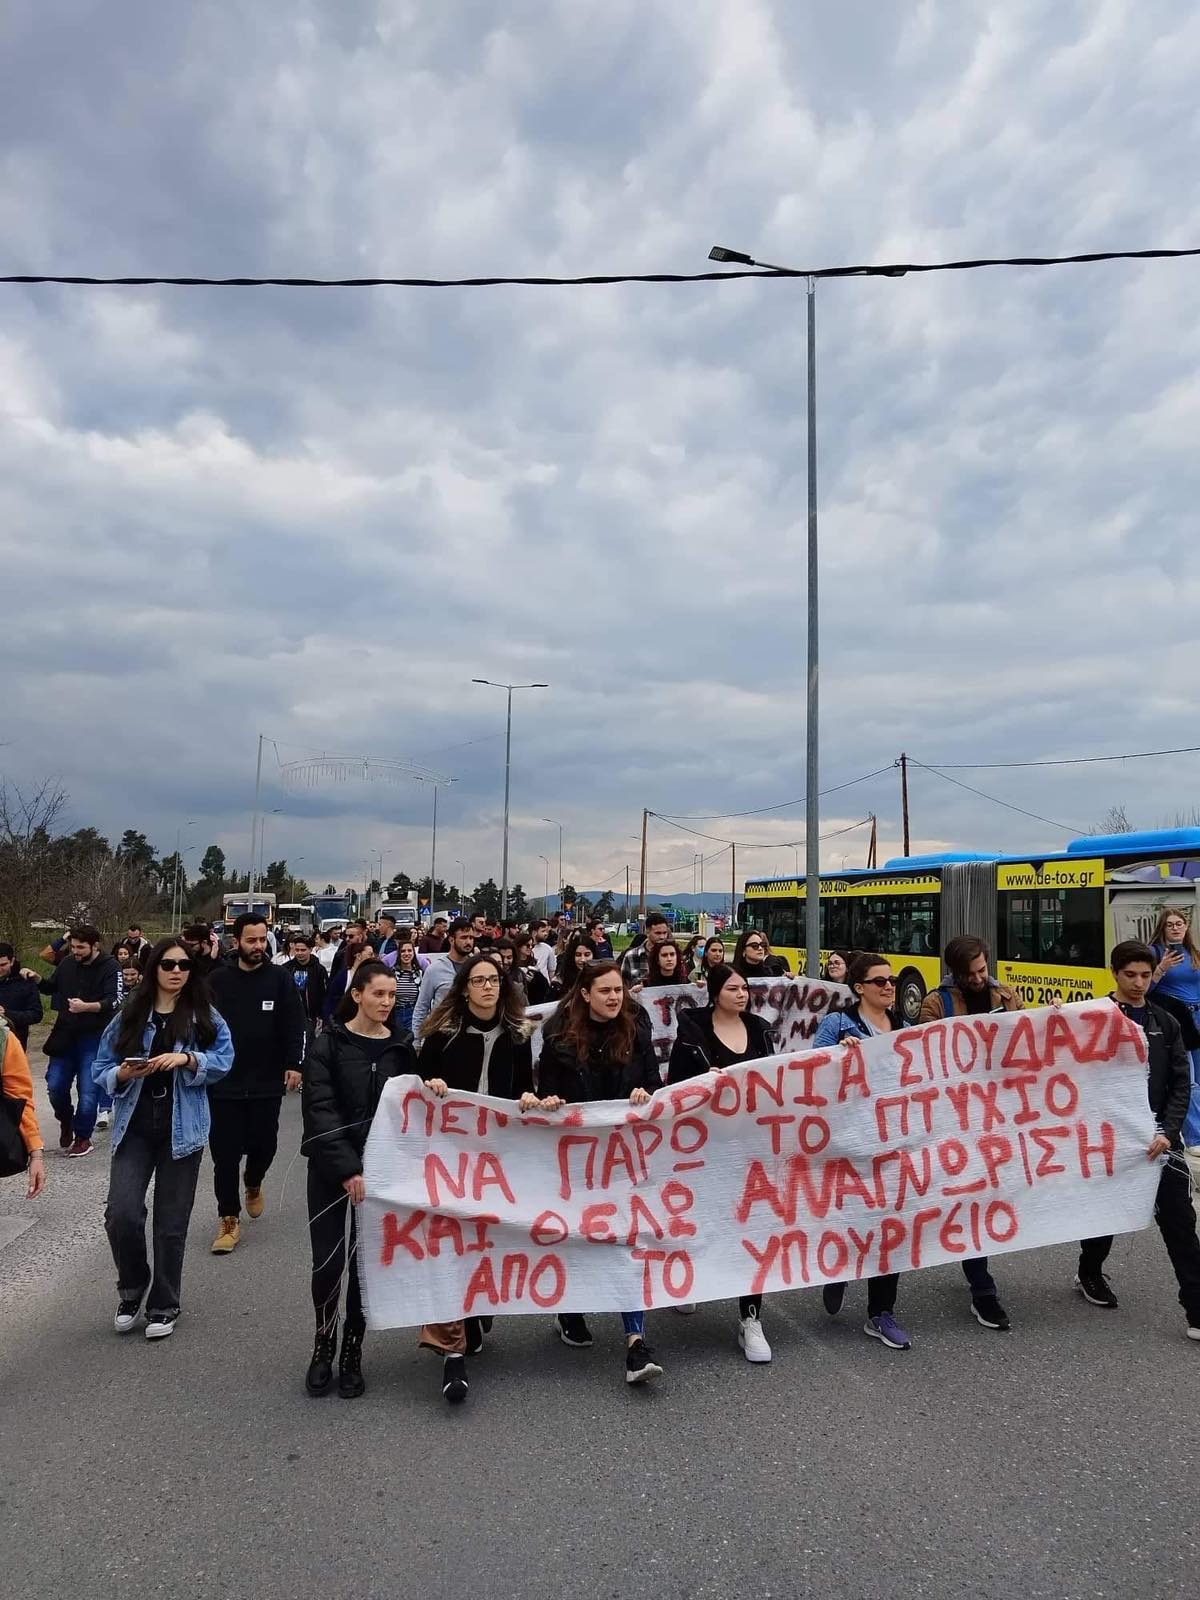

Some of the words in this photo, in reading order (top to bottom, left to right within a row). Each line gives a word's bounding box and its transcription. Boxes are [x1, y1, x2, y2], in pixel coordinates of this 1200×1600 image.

[820, 881, 833, 893] 200
[1005, 870, 1095, 888] www.de-tox.gr
[1006, 974, 1042, 985] ΤΗΛΕΦΩΝΟ
[1043, 976, 1093, 990] ΠΑΡΑΓΓΕΛΙΩΝ
[893, 1006, 1148, 1087] ΣΠΟΥΔΑΖΑ
[424, 1152, 517, 1208] ΝΑ
[756, 1115, 830, 1155] ΤΟ
[875, 1072, 1079, 1143] ΠΤΥΧΙΟ
[380, 1209, 502, 1266] ΚΑΙ
[463, 1253, 568, 1313] ΑΠΟ
[631, 1249, 695, 1308] ΤΟ
[742, 1201, 1019, 1296] ΥΠΟΥΡΓΕΙΟ
